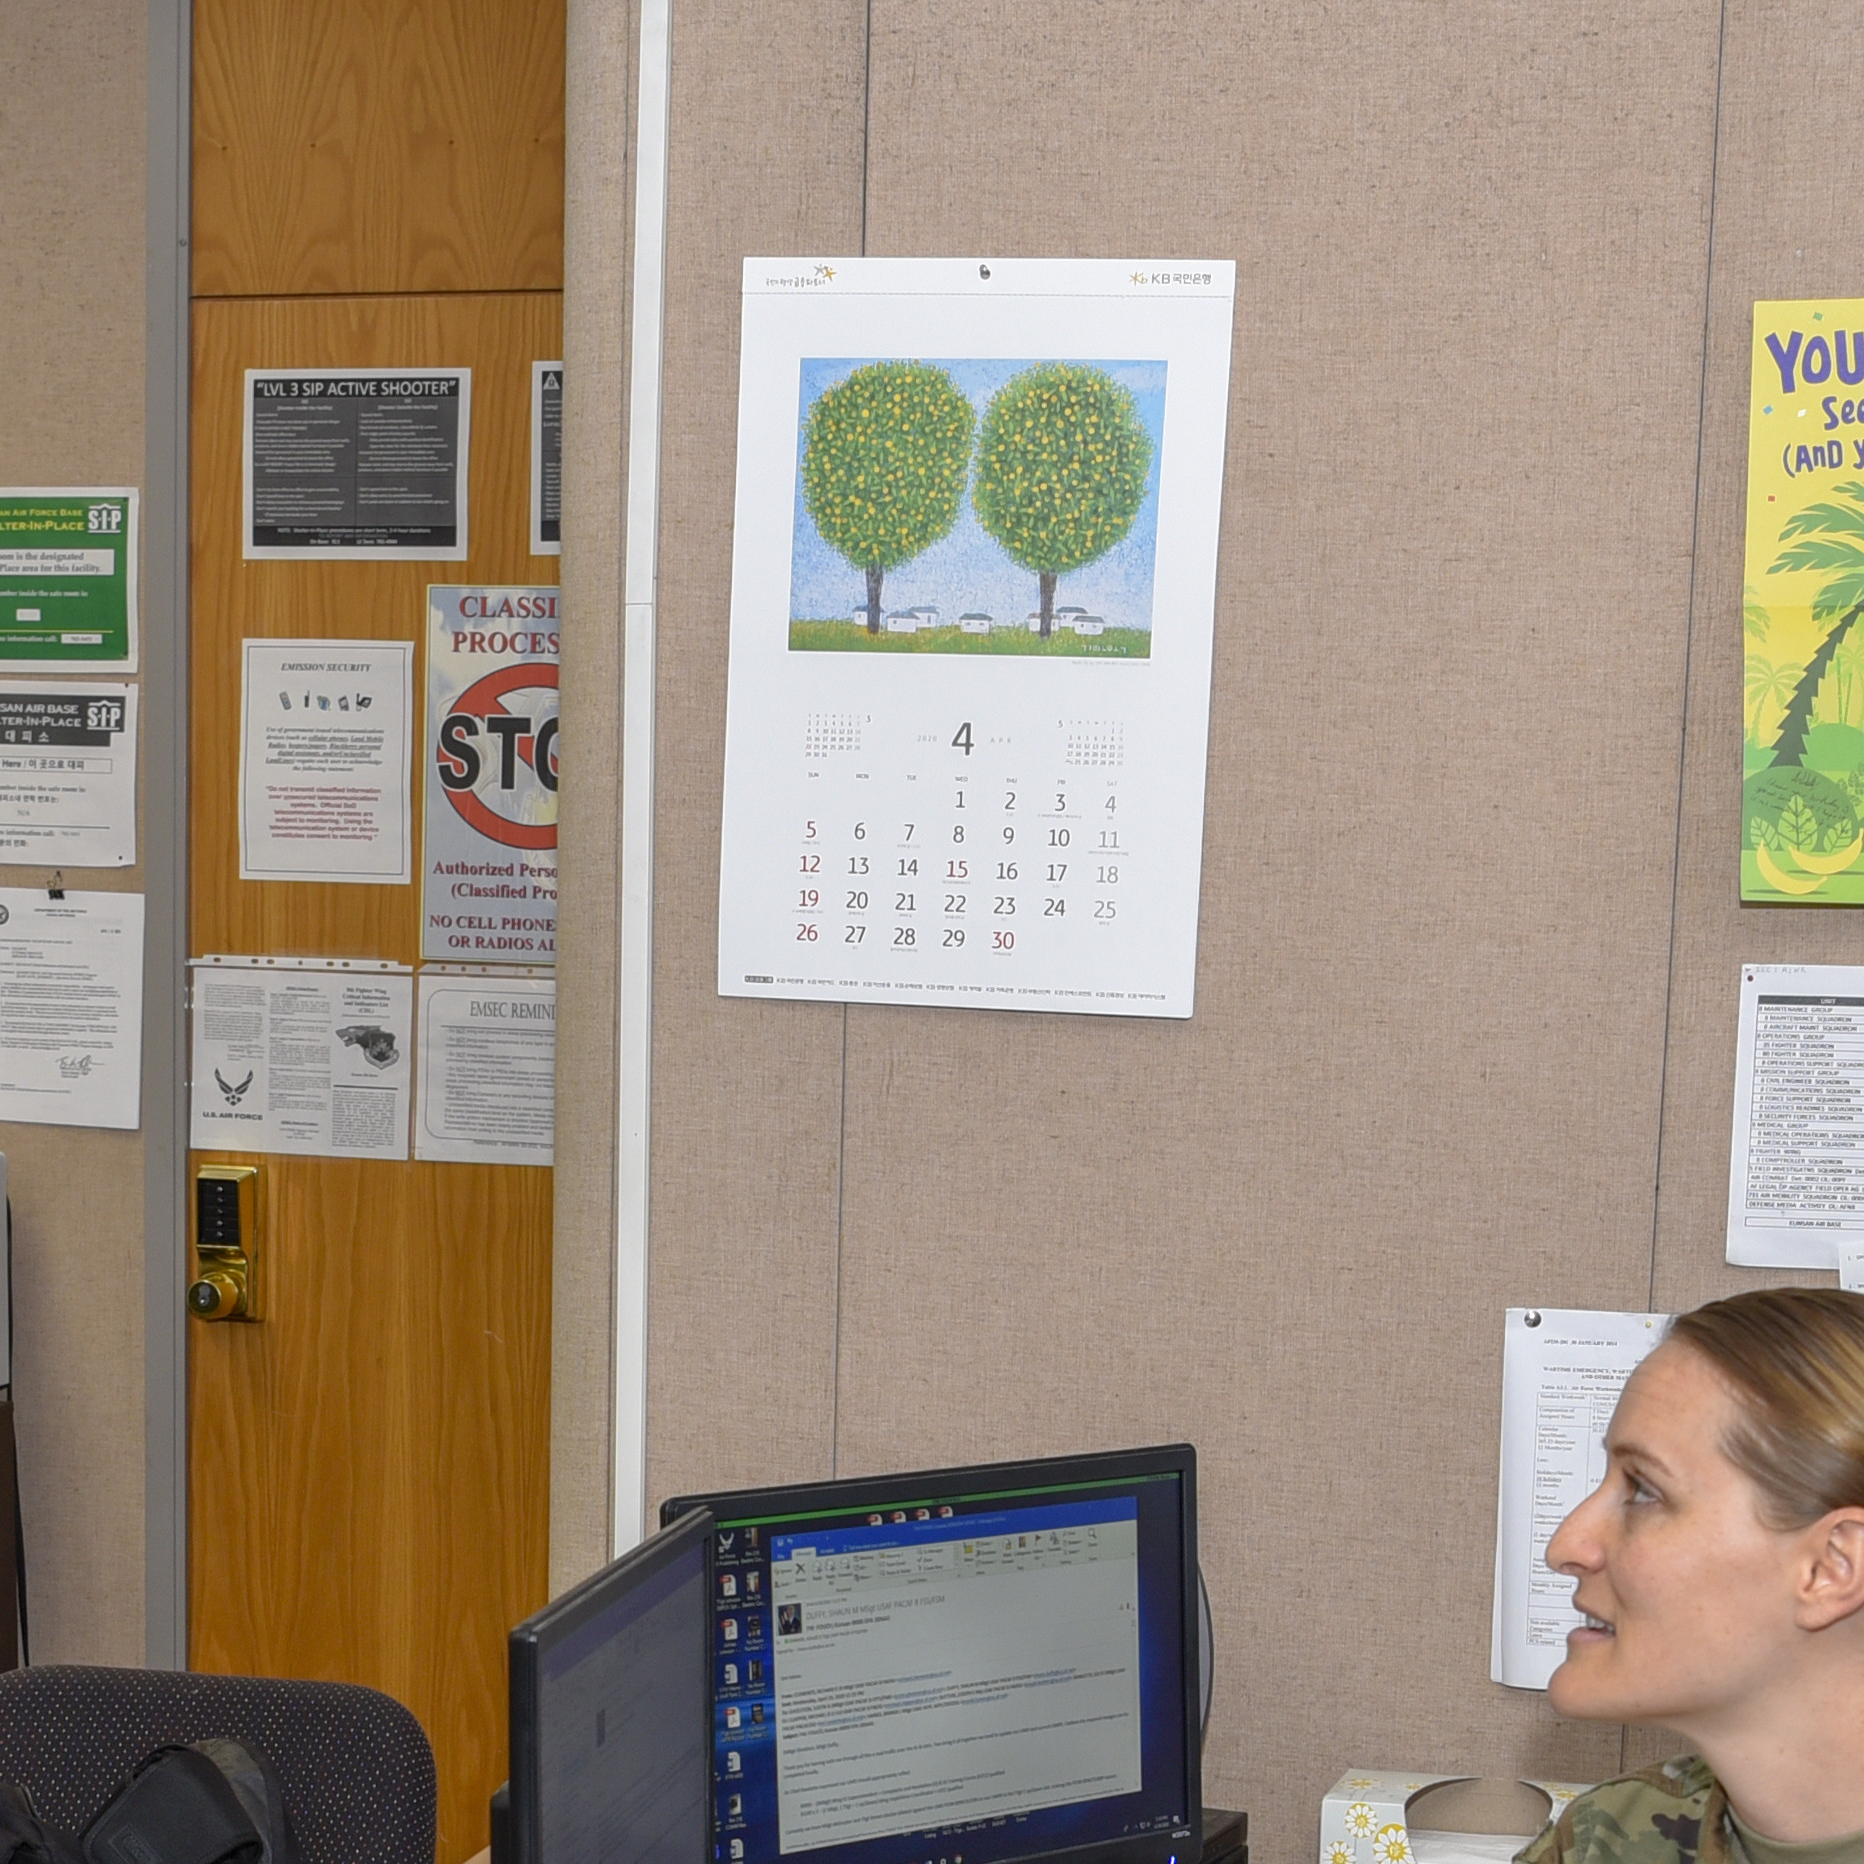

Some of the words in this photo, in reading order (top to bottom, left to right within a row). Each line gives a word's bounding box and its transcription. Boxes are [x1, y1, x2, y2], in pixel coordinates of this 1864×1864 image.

[1151, 273, 1170, 284] KB
[290, 382, 299, 396] 3
[302, 382, 325, 396] SIP
[327, 381, 378, 396] ACTIVE
[24, 552, 37, 560] the
[38, 552, 84, 562] designated
[281, 663, 325, 672] EMISSION
[326, 663, 372, 672] SECURITY
[25, 704, 46, 714] AIR
[47, 704, 79, 715] BASE
[951, 722, 975, 756] 4
[955, 791, 966, 809] 1
[1004, 792, 1016, 810] 2
[1054, 793, 1066, 812] 3
[1105, 795, 1117, 814] 4
[805, 821, 817, 838] 5
[854, 822, 866, 840] 6
[904, 824, 915, 842] 7
[952, 825, 965, 843] 8
[1002, 827, 1015, 845] 9
[1047, 829, 1071, 847] 10
[1098, 831, 1120, 849] 11
[433, 861, 514, 877] Authorized
[798, 855, 821, 873] 12
[847, 857, 870, 875] 13
[897, 858, 919, 876] 14
[946, 860, 968, 878] 15
[996, 862, 1019, 880] 16
[1045, 864, 1068, 882] 17
[1096, 866, 1119, 884] 18
[451, 883, 527, 900] (Classified
[798, 889, 819, 907] 19
[846, 891, 869, 909] 20
[895, 893, 917, 911] 21
[944, 894, 967, 913] 22
[993, 896, 1016, 915] 23
[1043, 898, 1066, 917] 24
[1093, 900, 1117, 919] 25
[429, 915, 452, 928] NO
[456, 915, 497, 930] CELL
[448, 935, 471, 948] OR
[475, 936, 534, 951] RADIOS
[796, 923, 819, 942] 26
[844, 925, 867, 944] 27
[893, 927, 916, 945] 28
[942, 929, 966, 947] 29
[991, 931, 1015, 949] 30
[470, 1000, 507, 1018] EMSEC
